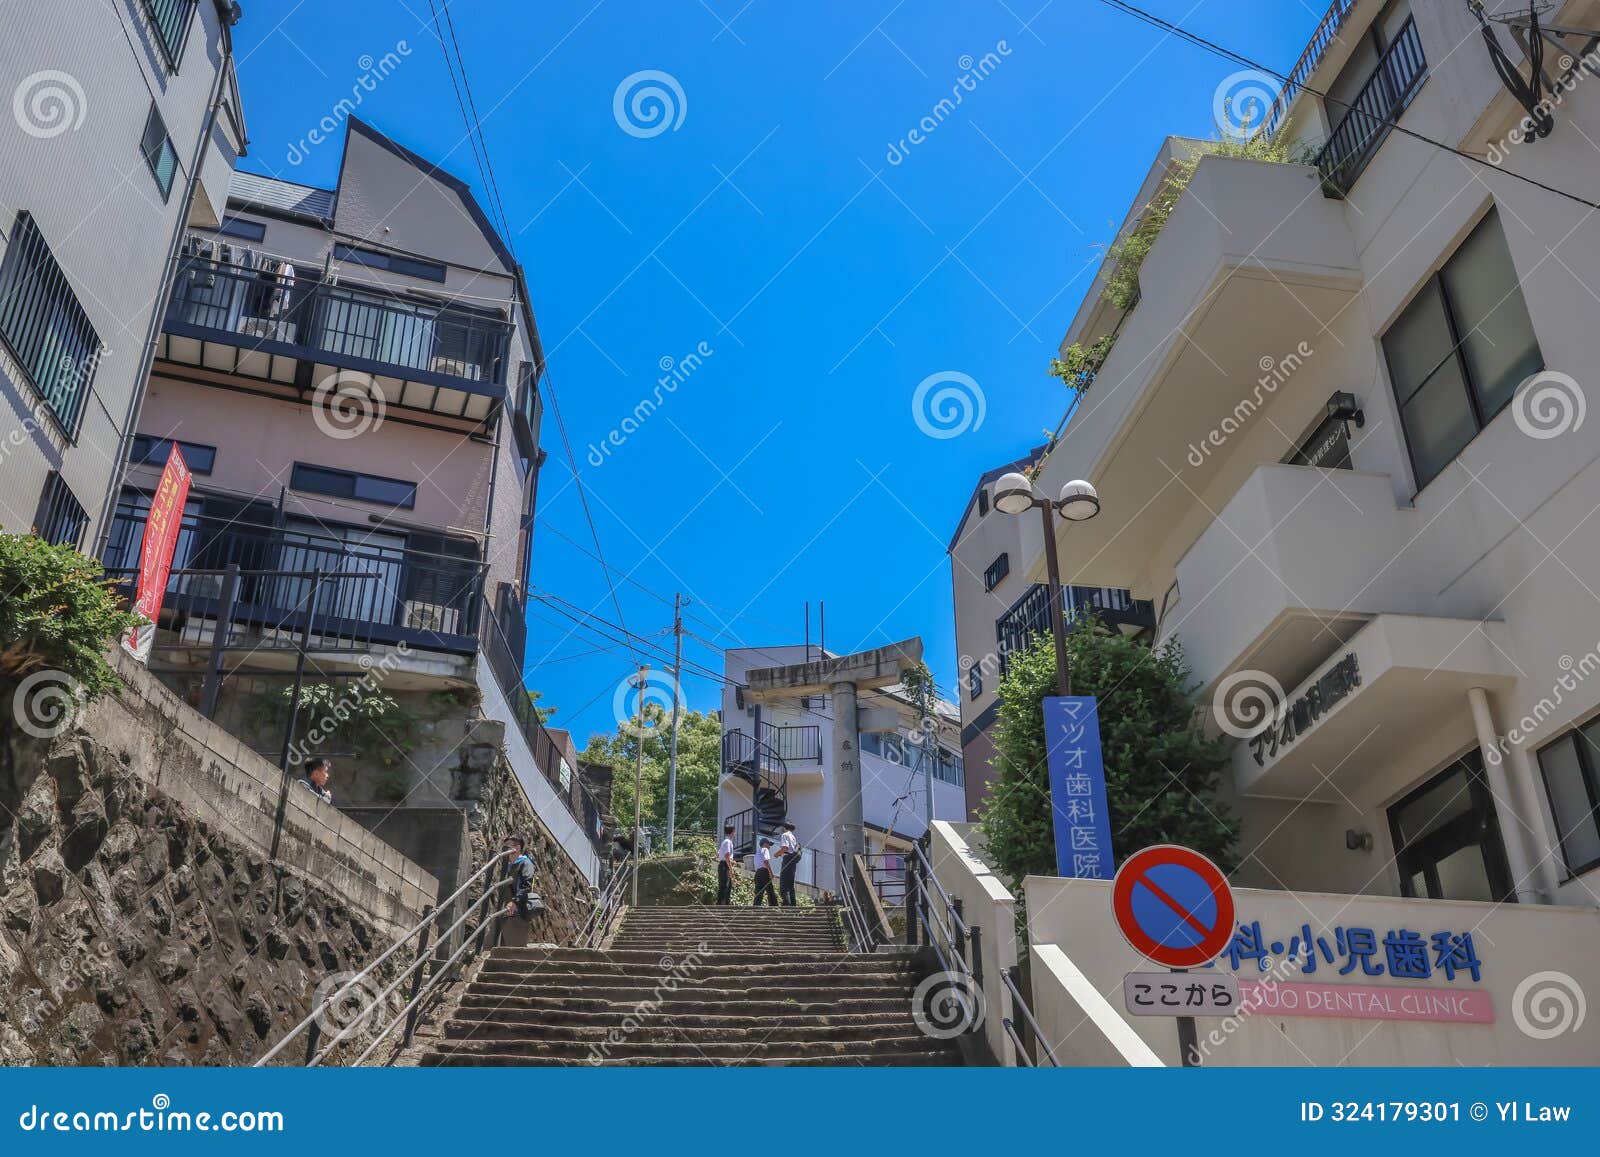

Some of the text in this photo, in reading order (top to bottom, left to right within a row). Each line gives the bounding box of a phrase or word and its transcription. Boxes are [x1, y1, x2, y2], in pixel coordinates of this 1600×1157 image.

[1059, 700, 1102, 880] マツオ歯科医院
[1204, 920, 1482, 982] 科・小児歯科
[1134, 983, 1233, 1006] ここから
[1305, 991, 1396, 1013] DENTAL
[1400, 993, 1474, 1017] CLINIC
